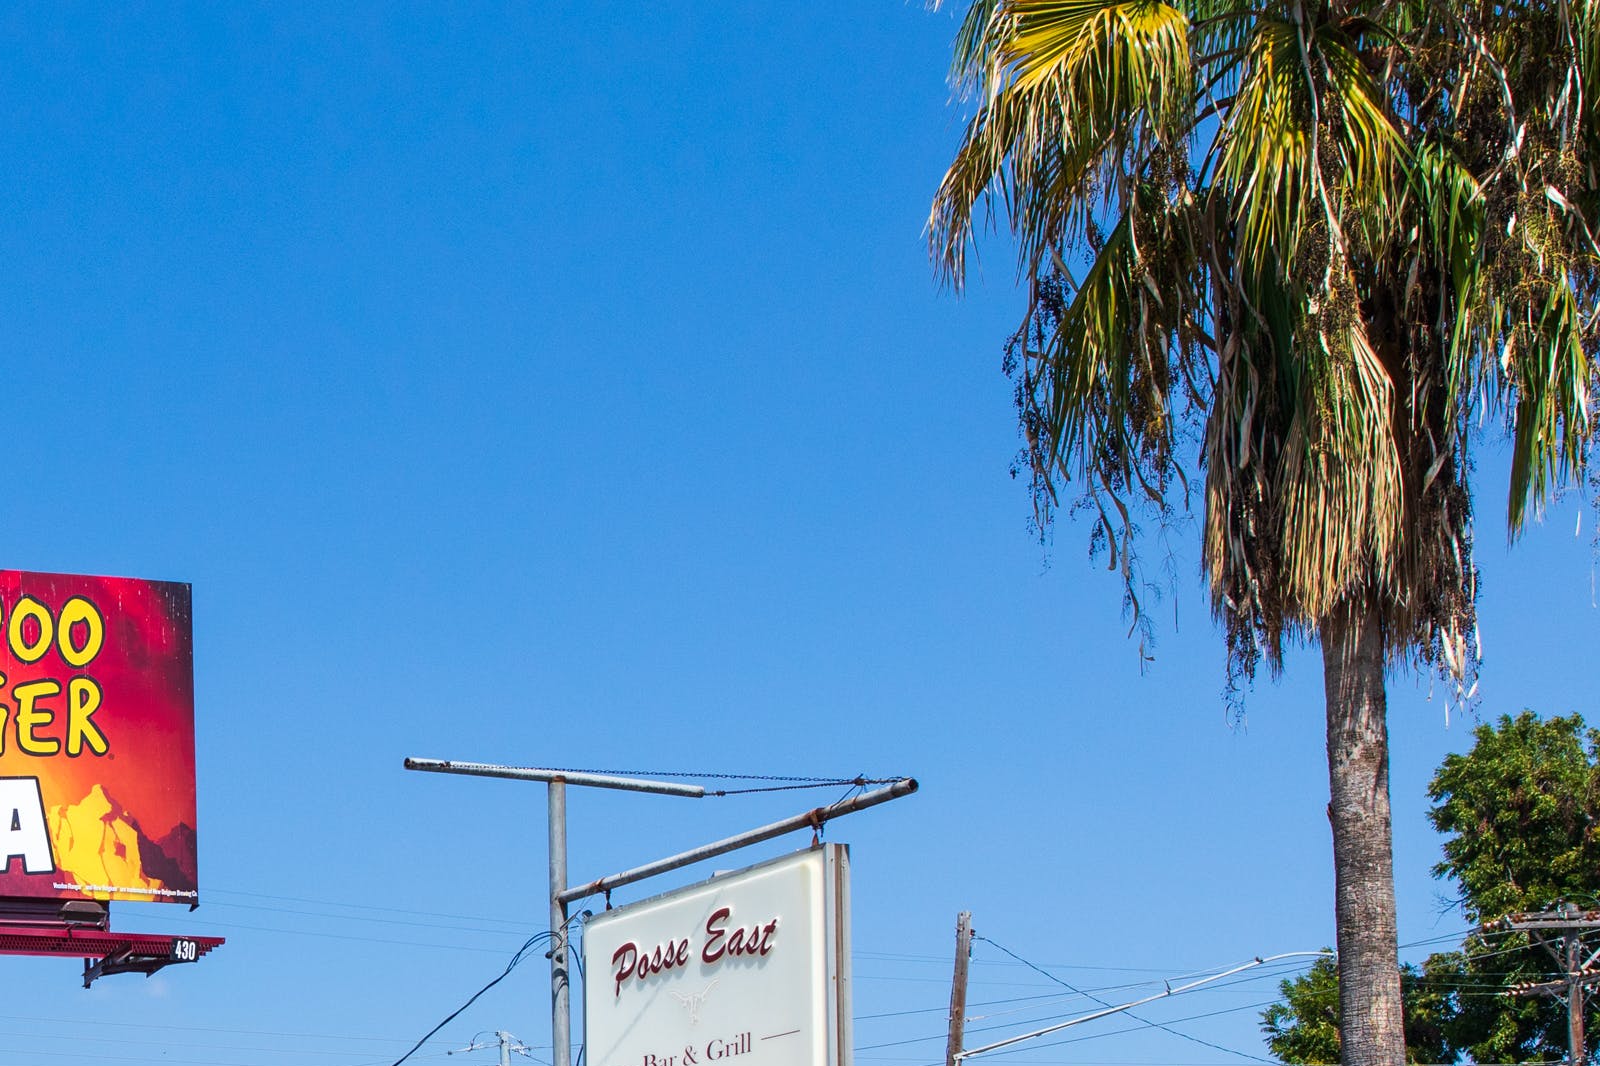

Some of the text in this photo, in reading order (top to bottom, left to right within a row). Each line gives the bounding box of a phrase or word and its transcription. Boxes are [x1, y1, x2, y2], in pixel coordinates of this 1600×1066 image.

[175, 940, 196, 960] 430
[611, 907, 777, 997] Posse East
[682, 1045, 698, 1066] &
[706, 1031, 752, 1061] Grill
